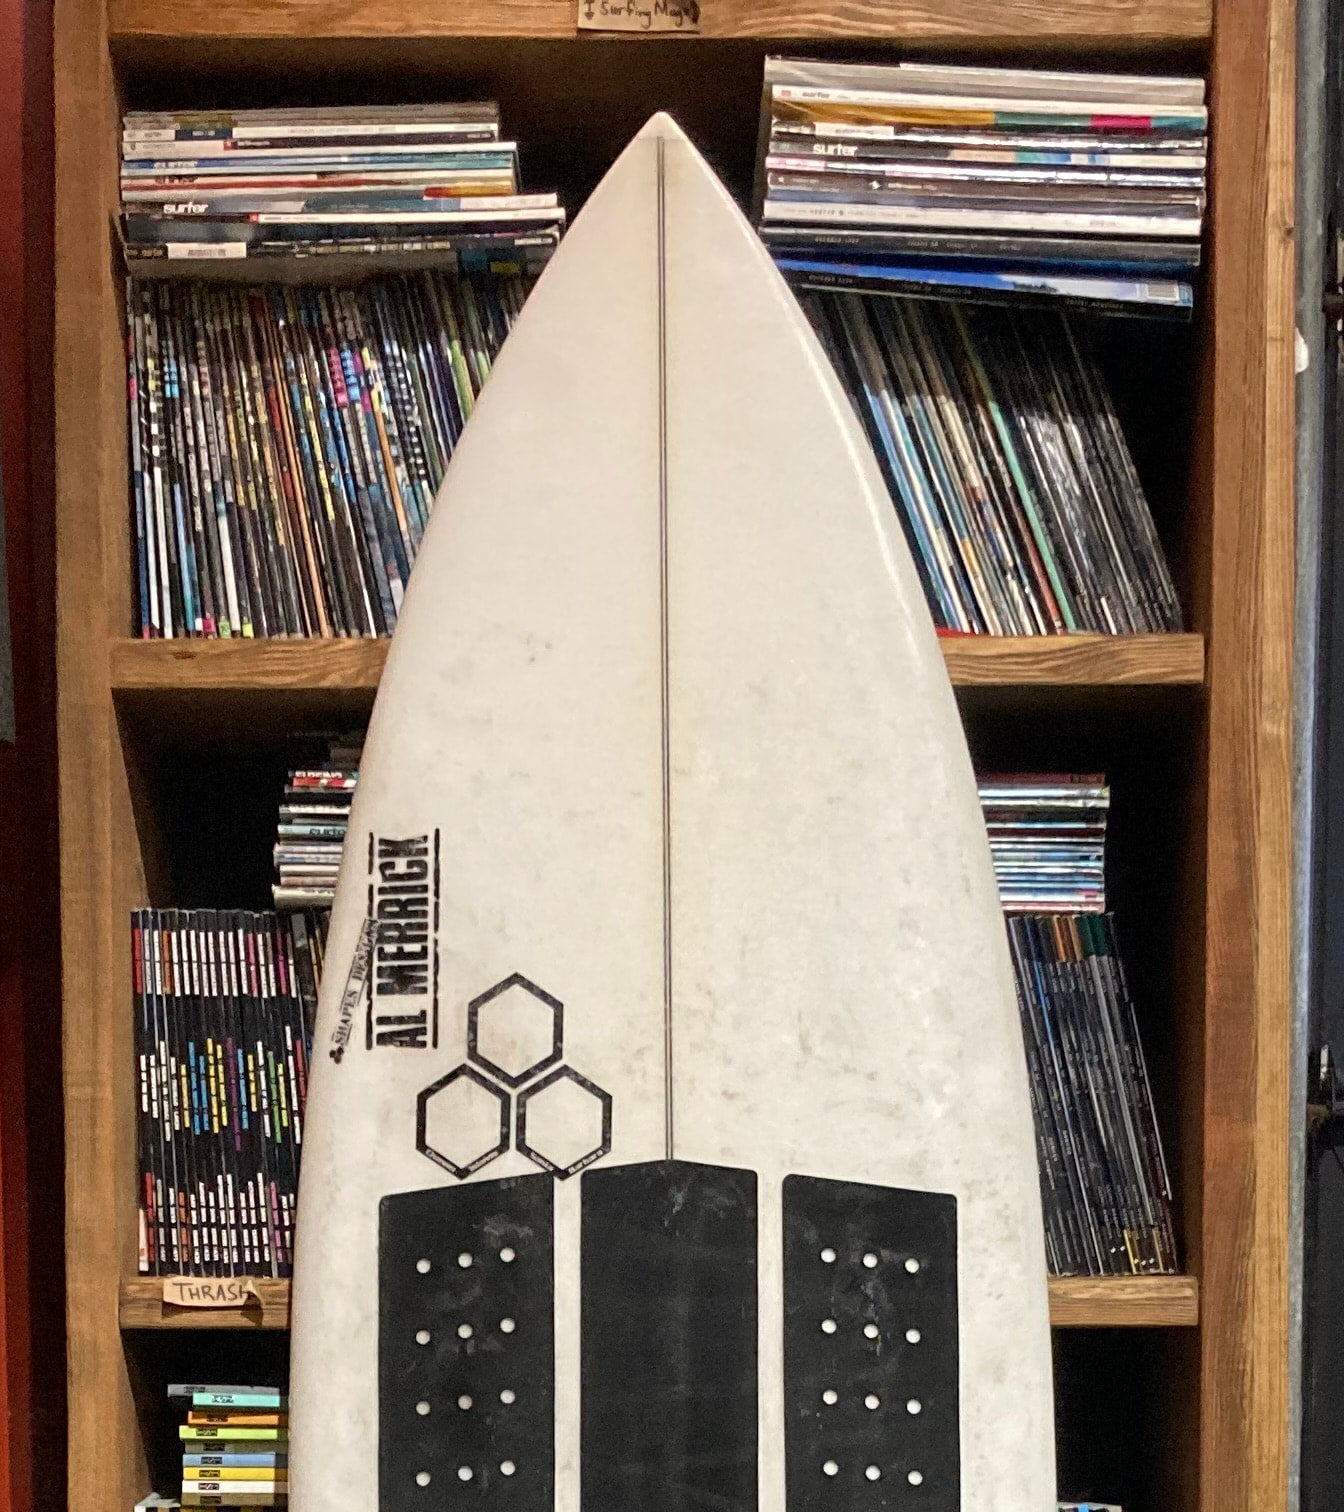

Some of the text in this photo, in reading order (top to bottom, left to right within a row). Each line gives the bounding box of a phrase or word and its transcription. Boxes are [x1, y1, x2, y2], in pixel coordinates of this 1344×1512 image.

[813, 143, 858, 157] surfer
[163, 201, 208, 214] surfer
[376, 835, 428, 1049] AL MERRICK
[335, 990, 358, 1047] SHAPES
